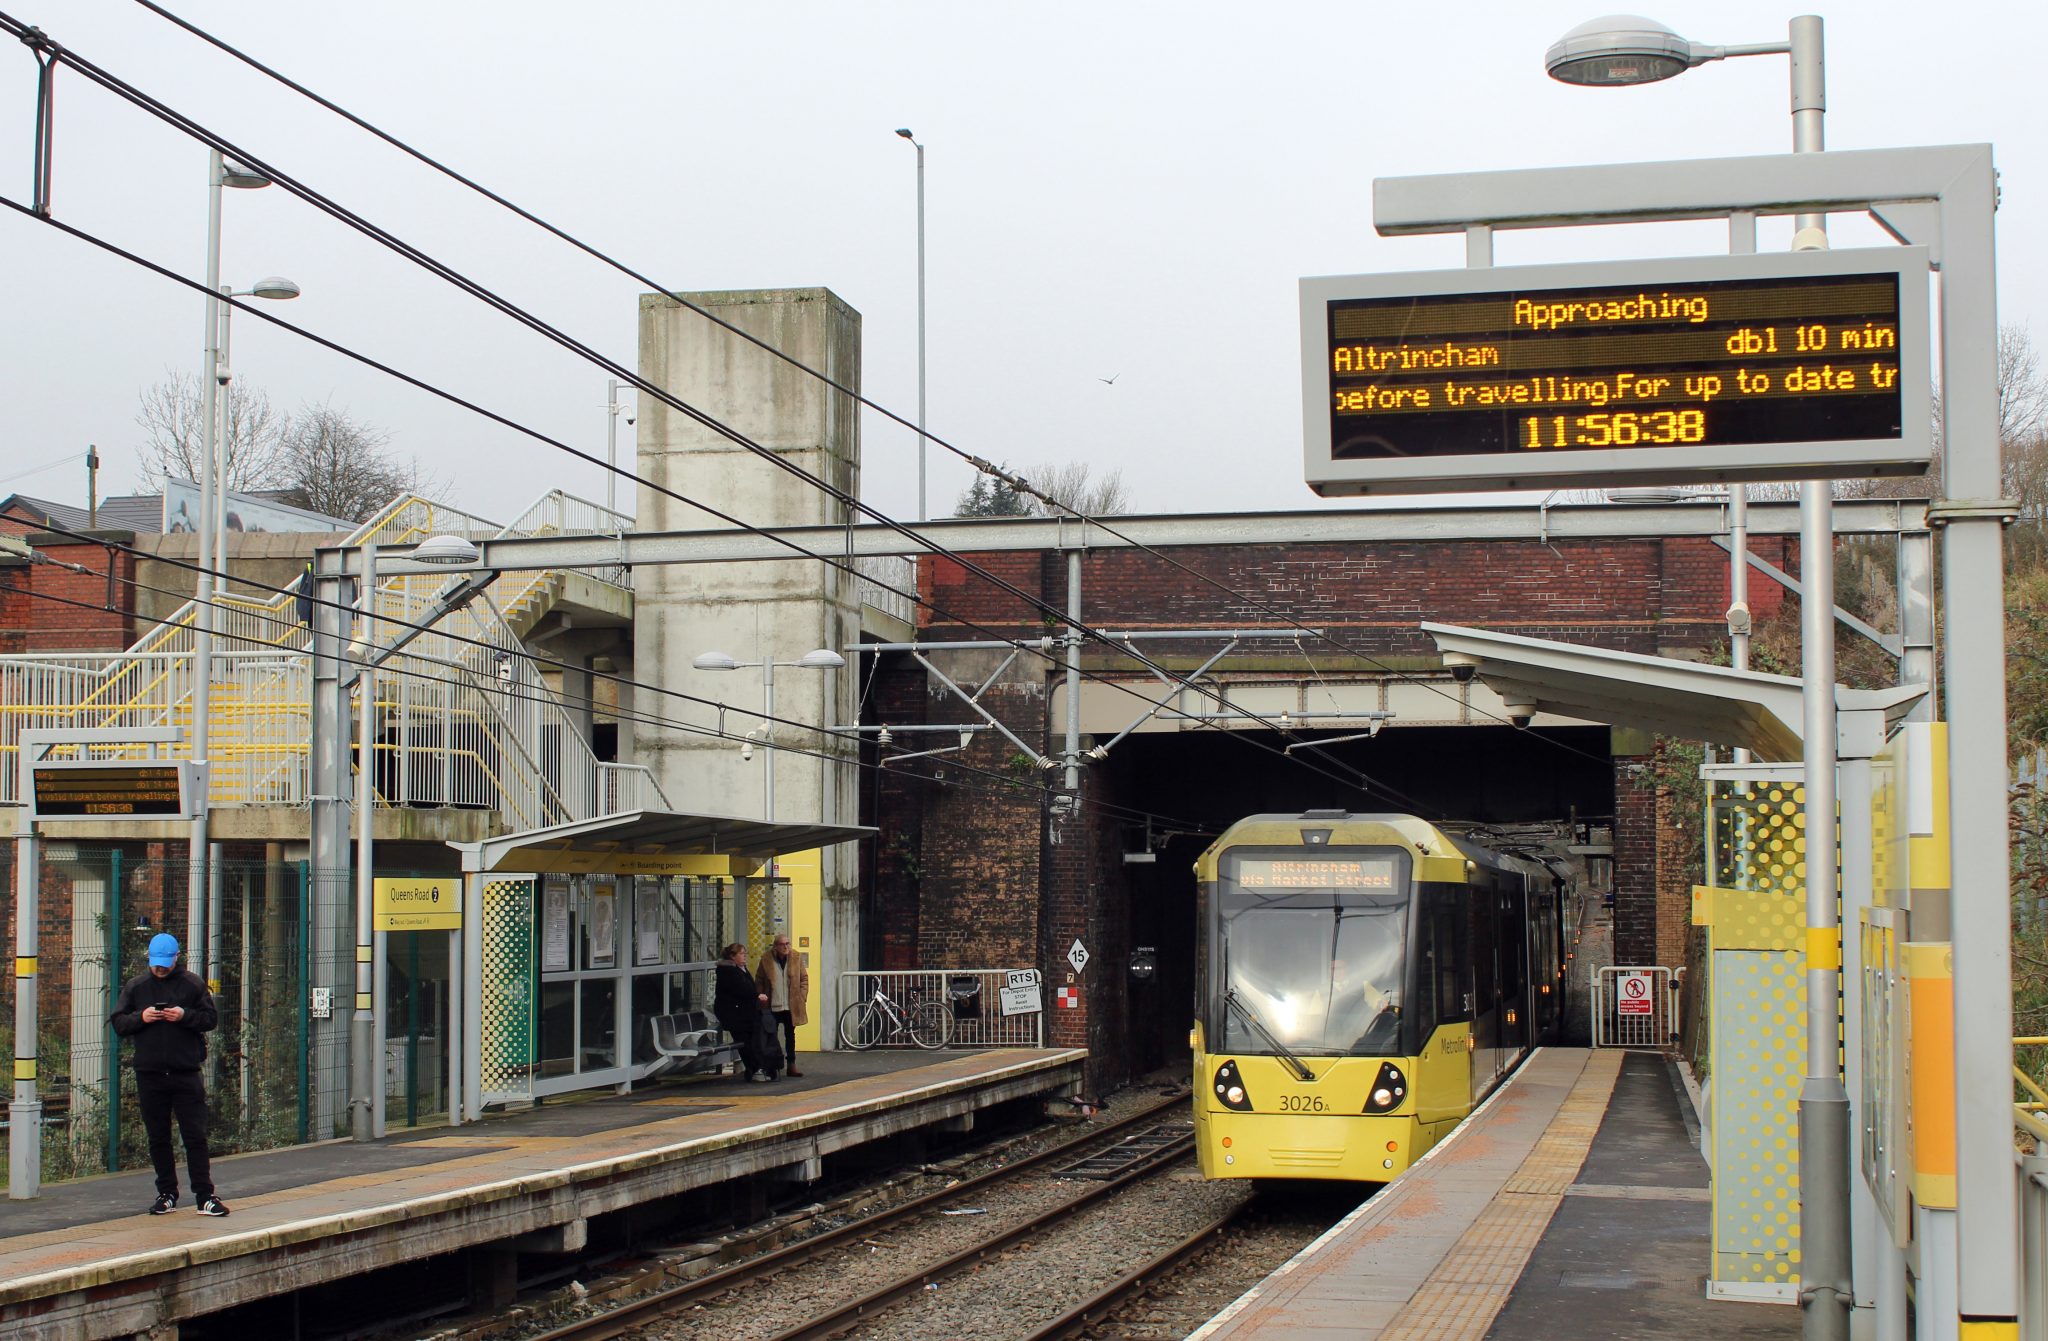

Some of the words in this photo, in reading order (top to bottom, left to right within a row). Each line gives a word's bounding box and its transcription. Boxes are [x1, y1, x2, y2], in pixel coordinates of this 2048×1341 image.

[1515, 293, 1708, 330] Approaching
[1334, 342, 1499, 372] Altrincham
[1796, 325, 1827, 351] 10
[1842, 323, 1895, 349] min
[1686, 376, 1722, 402] up
[1736, 368, 1770, 393] to
[1785, 364, 1856, 392] date
[1527, 410, 1705, 448] 11:56:38
[665, 862, 682, 870] point
[1241, 875, 1264, 886] via
[1272, 875, 1327, 886] Market
[1336, 875, 1390, 886] Street
[390, 888, 414, 903] Queens
[414, 888, 430, 901] Road
[1071, 949, 1085, 963] 15
[1010, 972, 1033, 984] RTS
[1441, 1036, 1470, 1055] Metrolin
